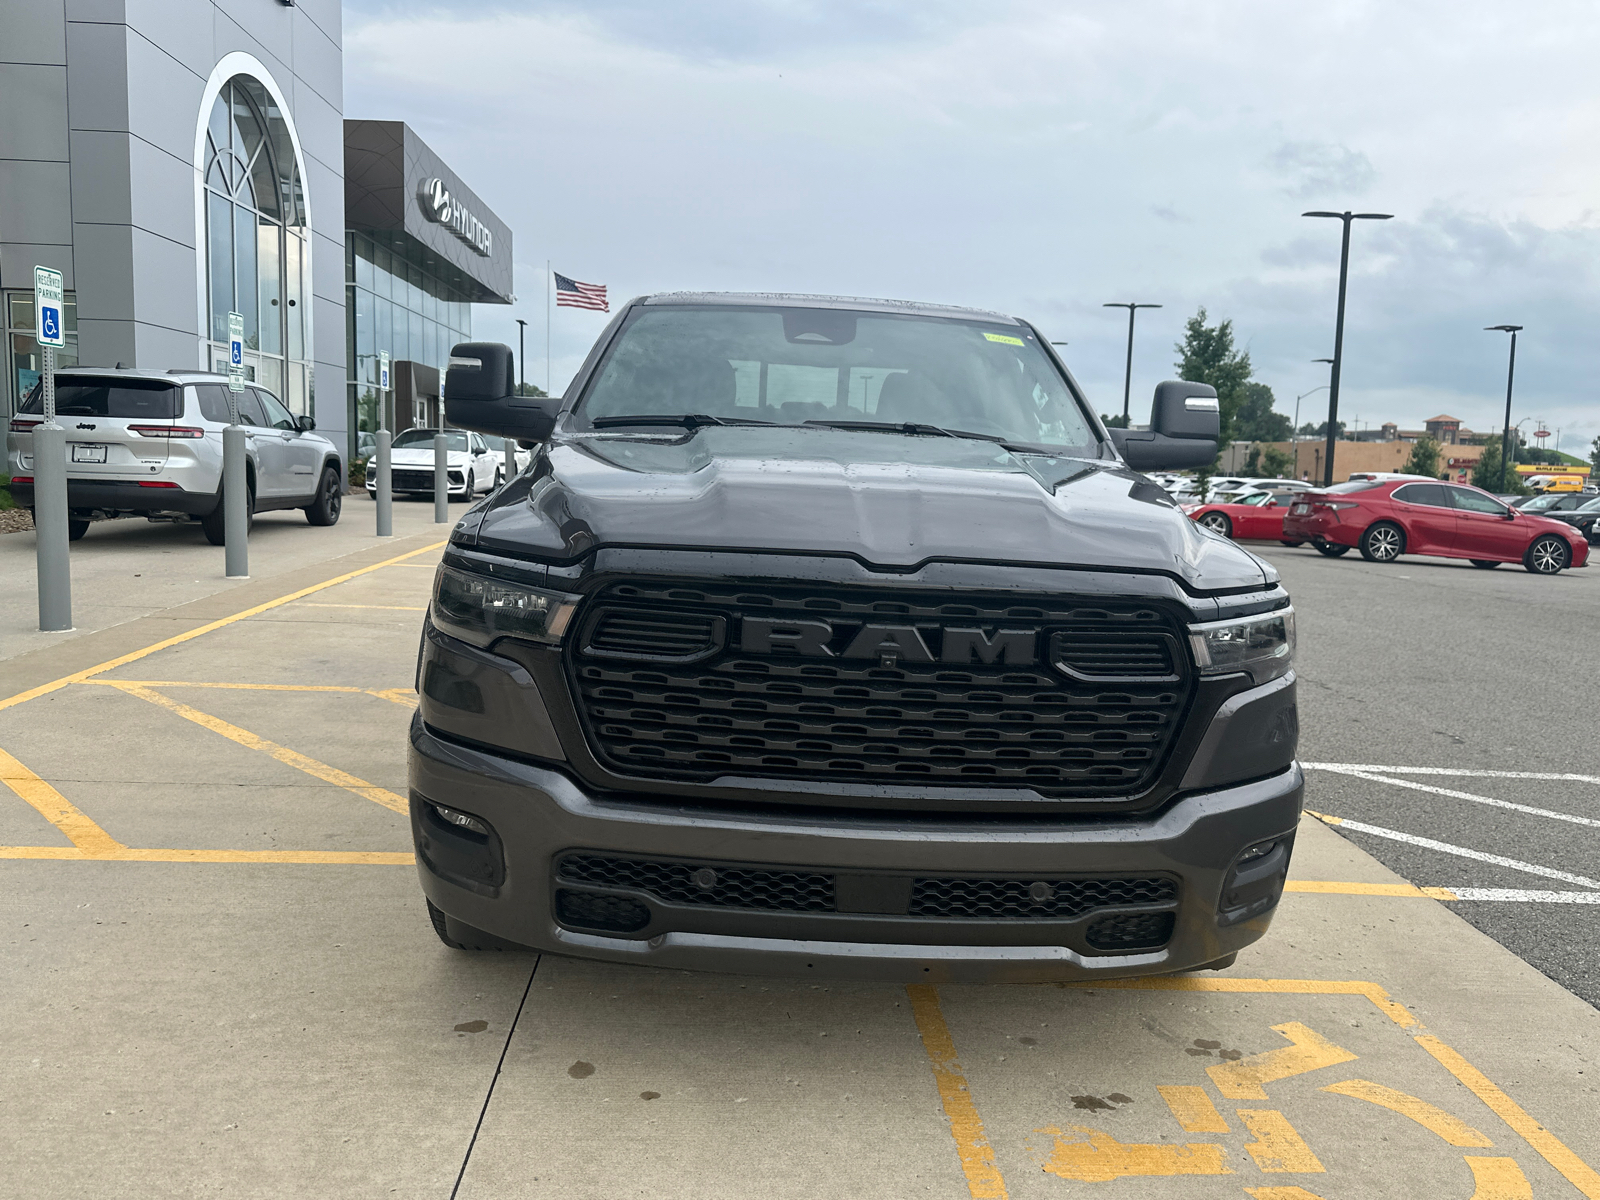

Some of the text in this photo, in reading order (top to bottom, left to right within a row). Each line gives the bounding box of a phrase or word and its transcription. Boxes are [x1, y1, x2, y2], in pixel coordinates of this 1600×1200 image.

[453, 197, 492, 257] HYUNDAI
[38, 274, 60, 289] RESERVED
[38, 287, 61, 302] PARKING
[76, 422, 96, 431] Jeep
[741, 616, 1036, 665] RAM
